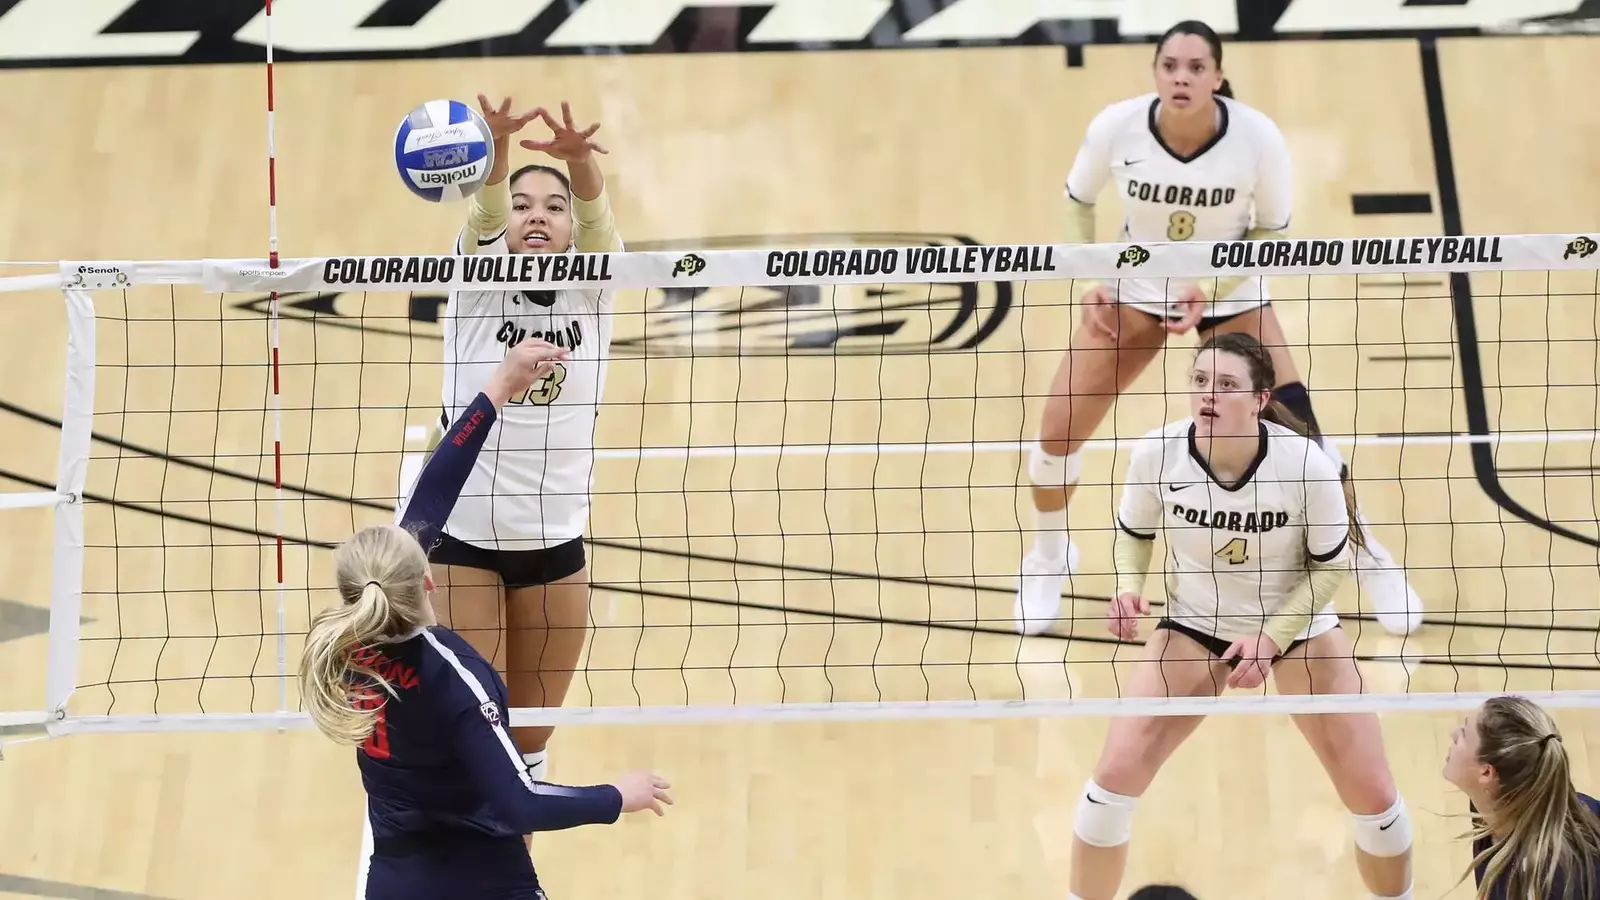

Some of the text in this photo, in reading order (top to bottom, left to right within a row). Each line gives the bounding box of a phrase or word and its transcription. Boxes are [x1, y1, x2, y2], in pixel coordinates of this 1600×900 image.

[423, 145, 468, 169] NCAA
[420, 165, 477, 185] molten
[1127, 179, 1236, 208] COLORADO
[1166, 210, 1196, 241] 8
[766, 246, 1056, 278] COLORADO VOLLEYBALL
[1211, 237, 1503, 269] COLORADO VOLLEYBALL
[87, 266, 120, 274] Senoh
[323, 254, 612, 284] COLORADO VOLLEYBALL
[496, 320, 583, 352] CORADO
[452, 410, 485, 447] WILDCATS
[1172, 503, 1289, 534] COLORADO
[1214, 537, 1249, 565] 4
